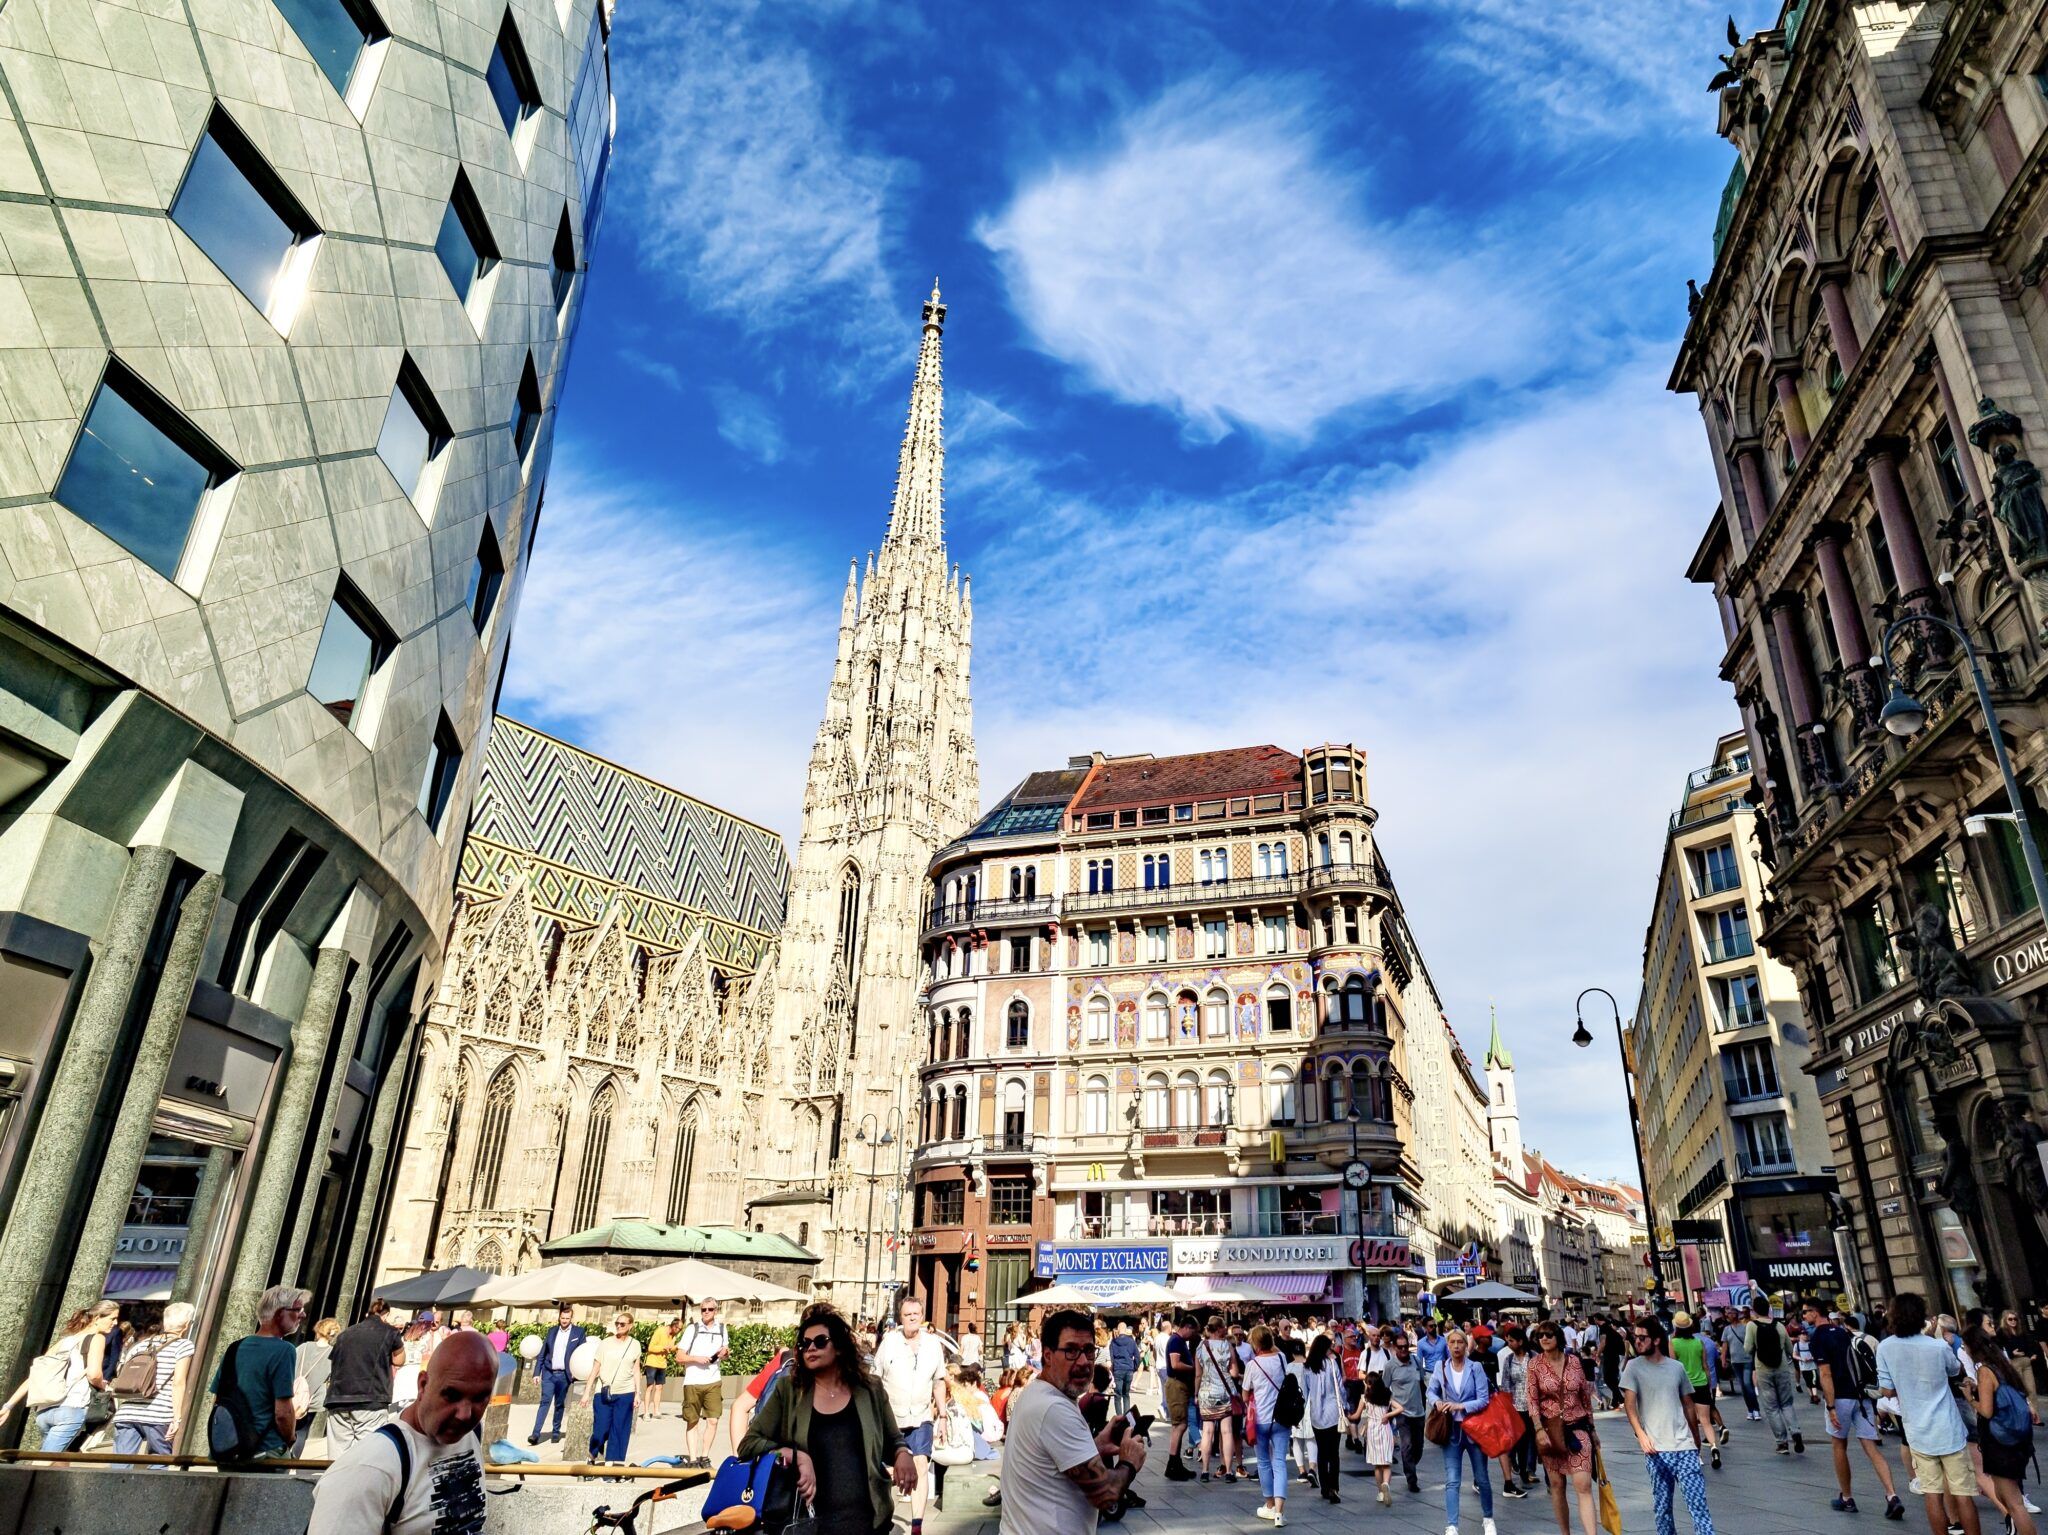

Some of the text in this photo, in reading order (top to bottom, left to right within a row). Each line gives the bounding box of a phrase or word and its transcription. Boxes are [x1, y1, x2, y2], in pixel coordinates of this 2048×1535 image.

[1056, 1251, 1168, 1270] MONEY EXCHANGE
[1226, 1247, 1333, 1262] KONDITOREI
[1768, 1262, 1834, 1278] HUMANIC
